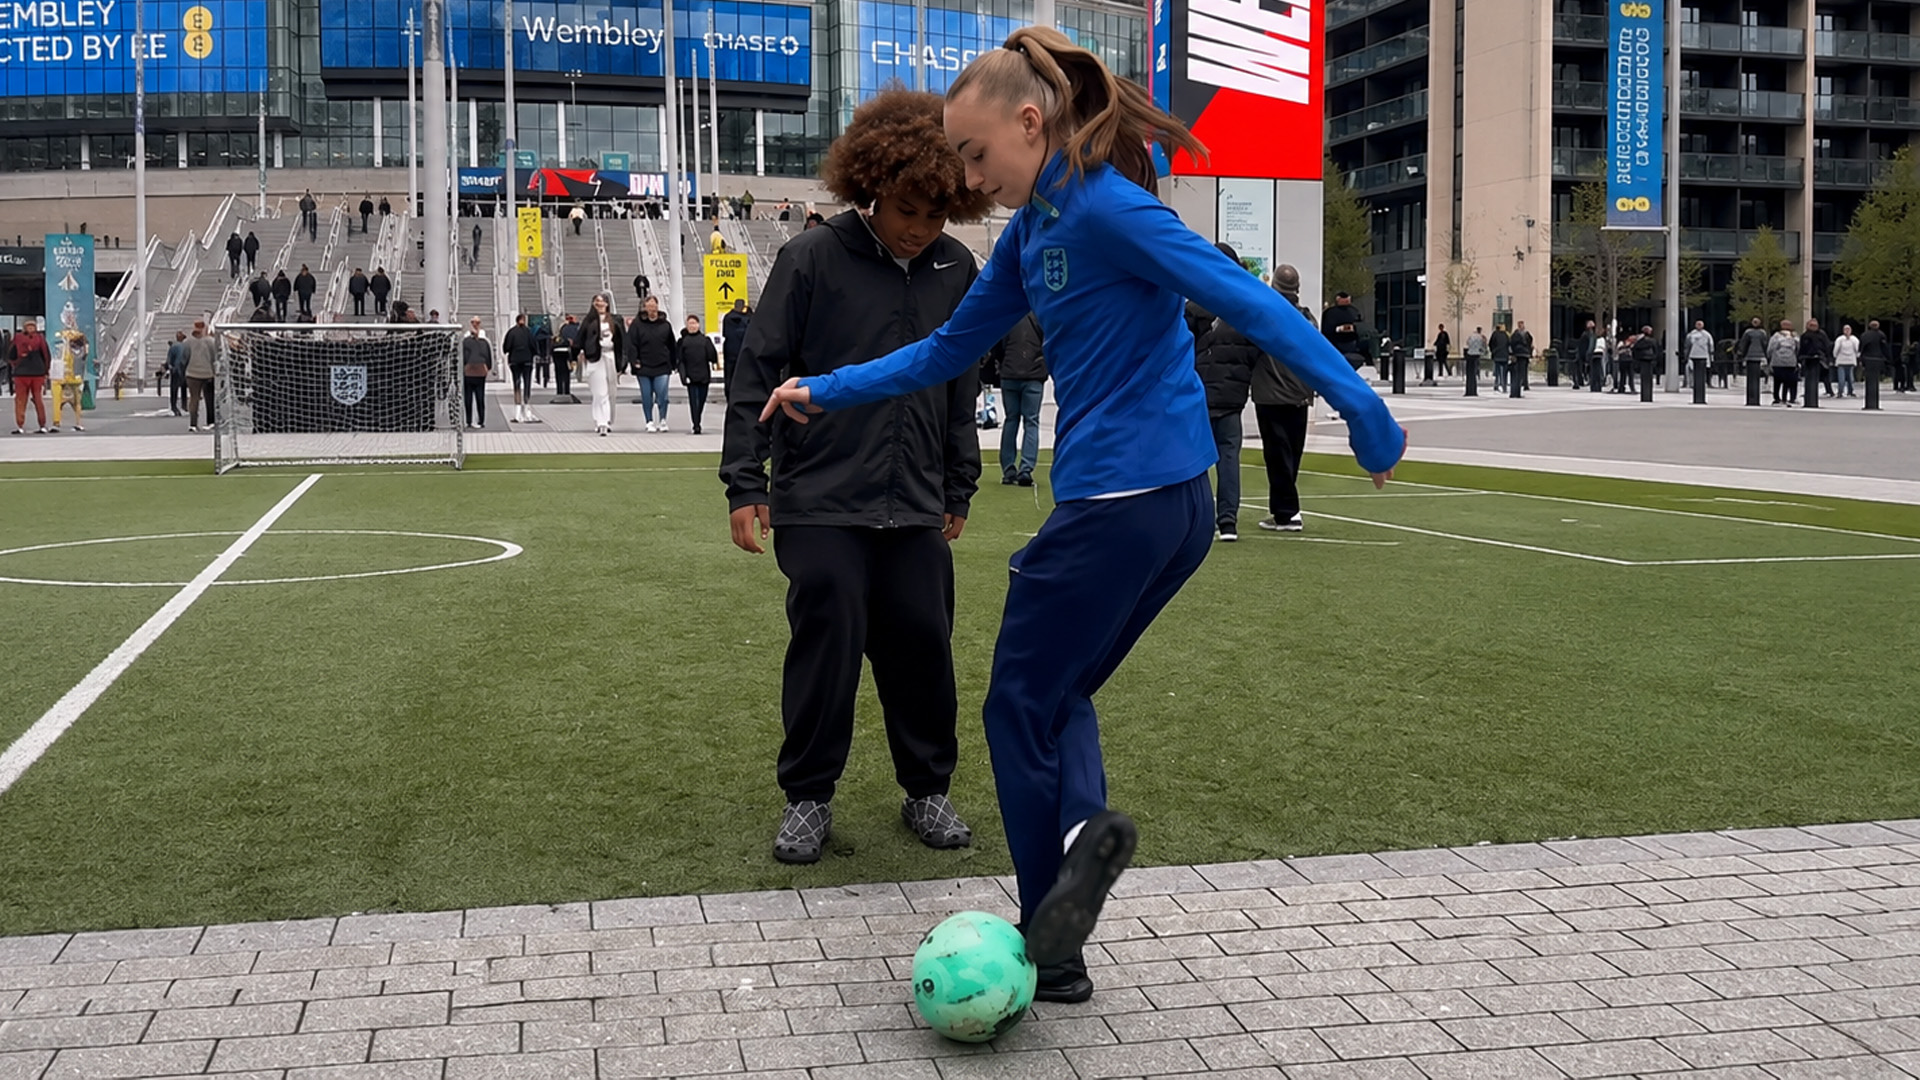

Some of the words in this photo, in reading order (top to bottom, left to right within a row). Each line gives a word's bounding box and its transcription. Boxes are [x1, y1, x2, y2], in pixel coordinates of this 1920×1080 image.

[83, 34, 121, 60] BY
[131, 34, 168, 59] EE
[522, 15, 664, 53] Wembley
[703, 31, 776, 52] CHASE
